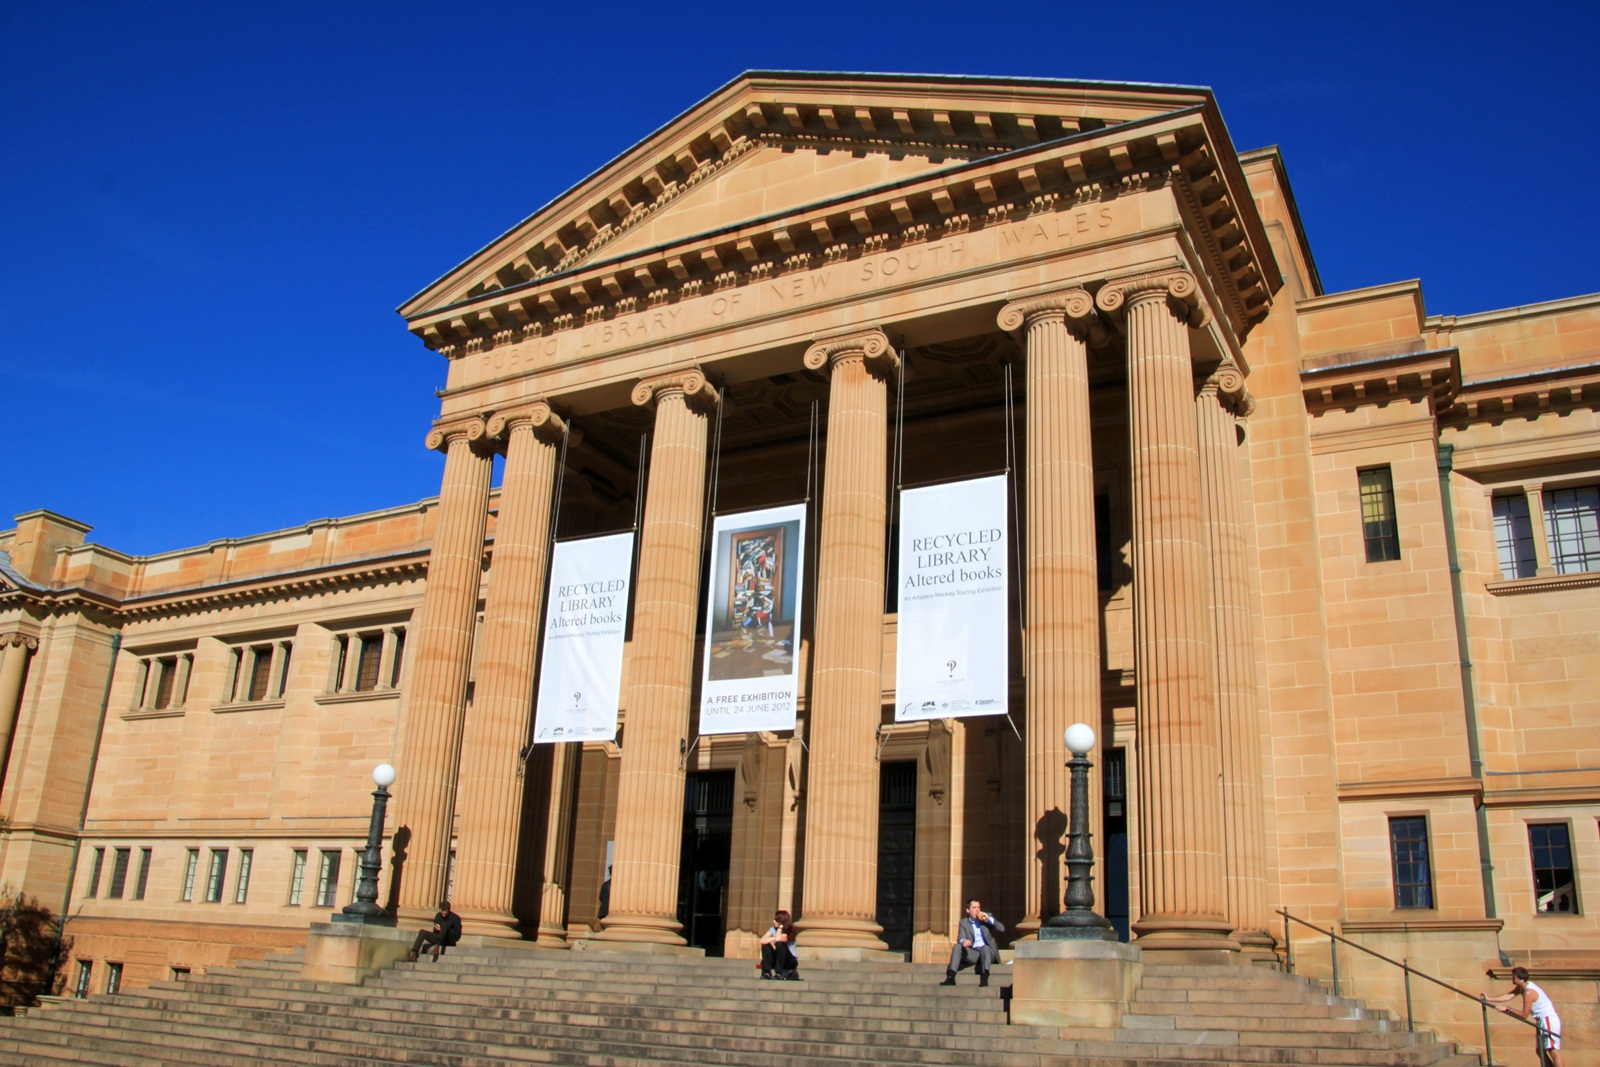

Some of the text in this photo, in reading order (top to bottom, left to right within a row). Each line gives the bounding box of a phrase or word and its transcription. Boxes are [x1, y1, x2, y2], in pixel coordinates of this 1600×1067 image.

[480, 207, 1113, 374] PUBLIC LIBRARY OF NEW SOUTH WALES
[912, 528, 1002, 552] RECYCLED
[917, 547, 991, 569] LIBRARY
[905, 565, 1002, 588] Altered books
[558, 579, 625, 597] RECYCLED
[912, 593, 934, 601] Artspace
[977, 586, 1002, 594] Exhibition
[560, 595, 616, 612] LIBRARY
[550, 611, 622, 629] Altered books
[707, 691, 791, 704] A FREE EXHIBITION
[706, 702, 791, 715] UNTIL 24 JUNE 2012
